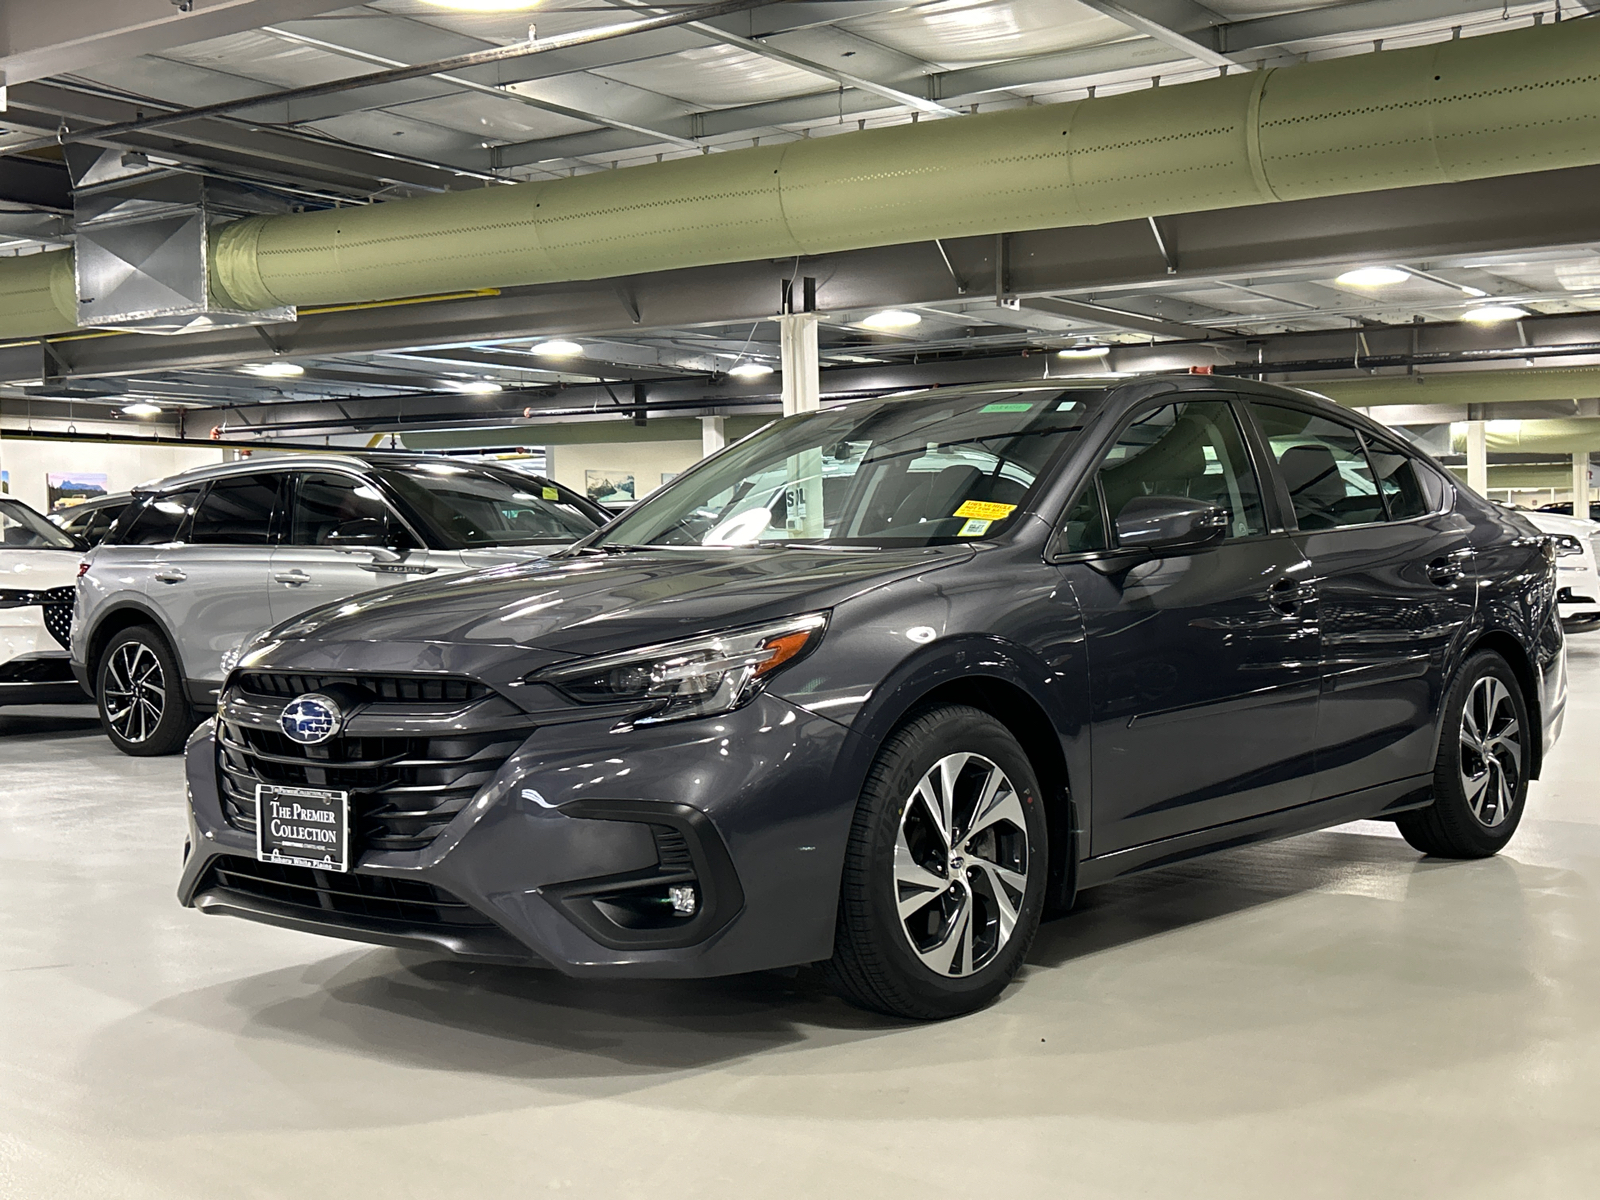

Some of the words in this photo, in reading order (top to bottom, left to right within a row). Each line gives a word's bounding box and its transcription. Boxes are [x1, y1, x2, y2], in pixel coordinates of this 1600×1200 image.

[270, 801, 291, 819] THE
[292, 803, 336, 824] PREMIER
[271, 819, 337, 843] COLLECTION
